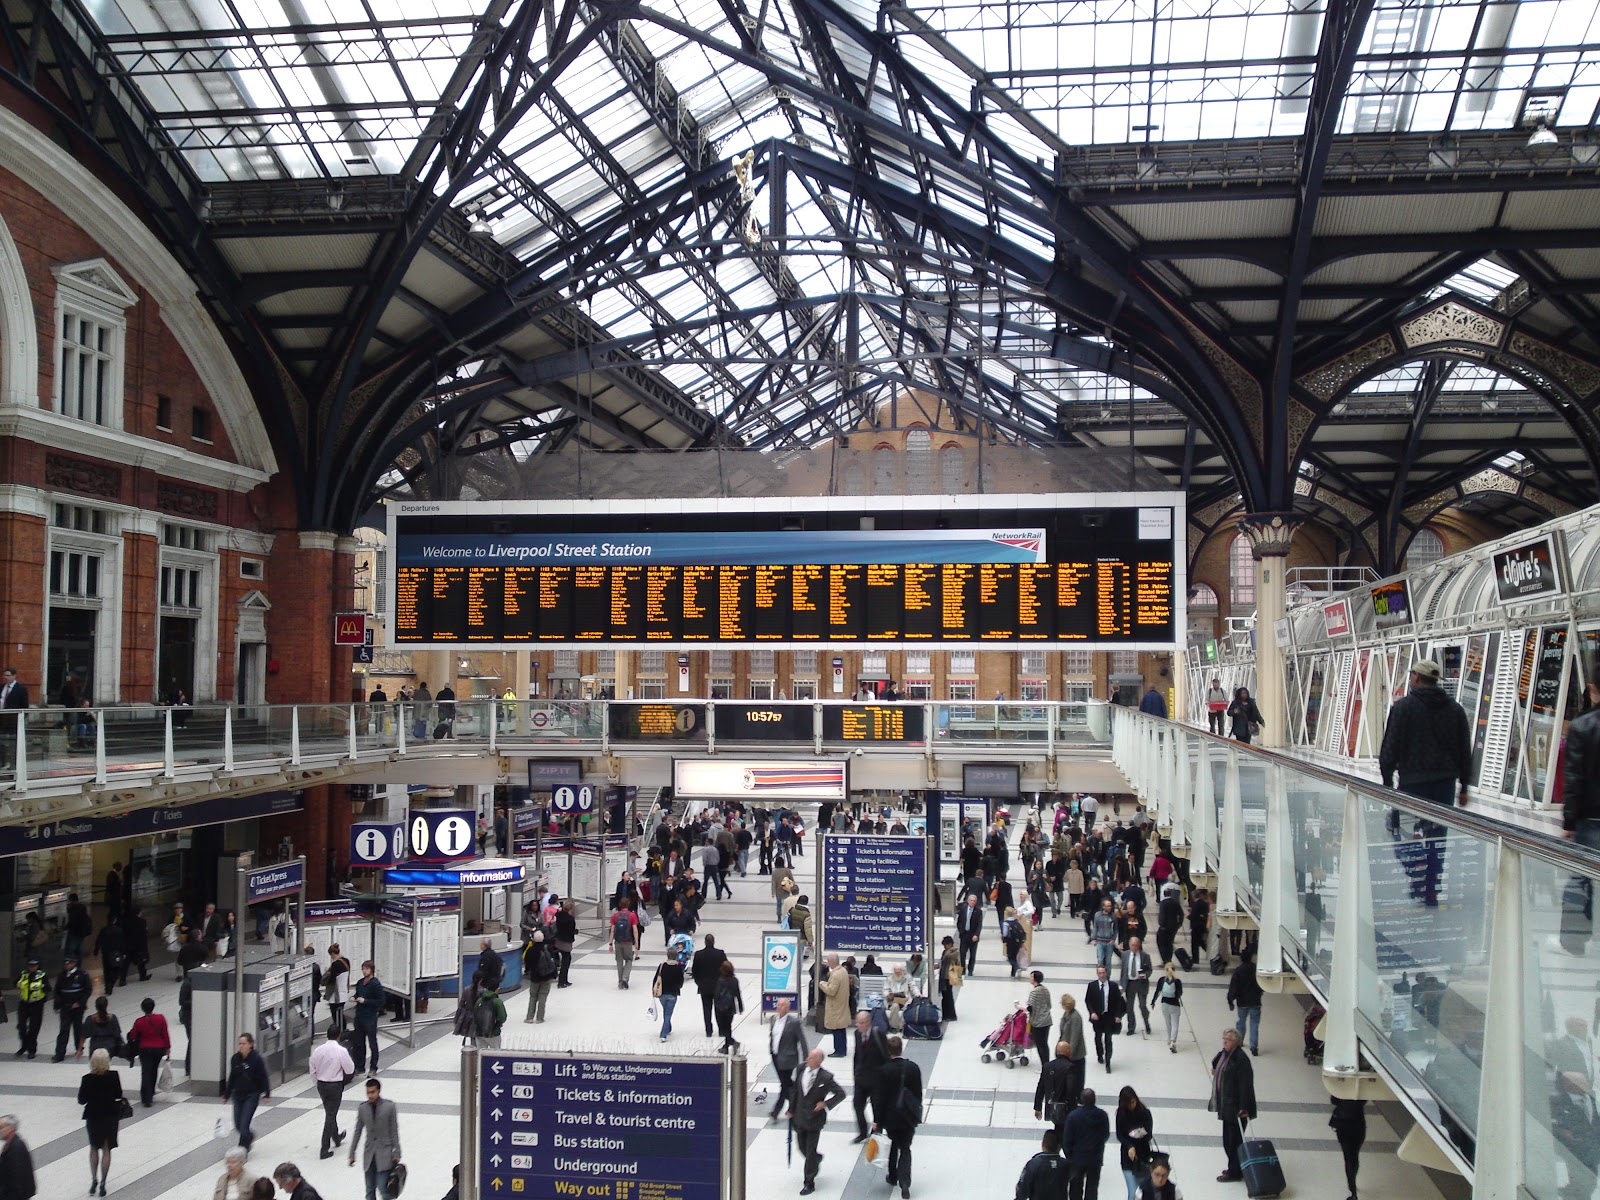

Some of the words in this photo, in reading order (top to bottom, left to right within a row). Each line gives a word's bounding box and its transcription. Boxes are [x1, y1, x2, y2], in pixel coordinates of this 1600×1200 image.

[402, 505, 440, 514] Departures
[422, 546, 472, 557] Welcome
[474, 547, 486, 557] to
[488, 544, 552, 560] Liverpool
[554, 543, 597, 557] Street
[600, 543, 652, 556] Station
[1504, 550, 1540, 587] claire's
[256, 872, 287, 885] TicketXpress
[460, 871, 513, 883] information
[555, 1064, 577, 1077] Lift
[592, 1064, 607, 1073] Way
[625, 1065, 672, 1075] Underground
[555, 1088, 601, 1102] Tickets
[604, 1089, 614, 1102] &
[618, 1090, 692, 1106] information
[555, 1111, 592, 1125] Travel
[595, 1112, 606, 1126] &
[609, 1114, 651, 1128] tourist
[654, 1117, 696, 1129] centre
[554, 1134, 578, 1148] Bus
[580, 1136, 625, 1150] station
[554, 1158, 638, 1175] Underground
[555, 1181, 583, 1197] Way
[587, 1184, 611, 1196] out
